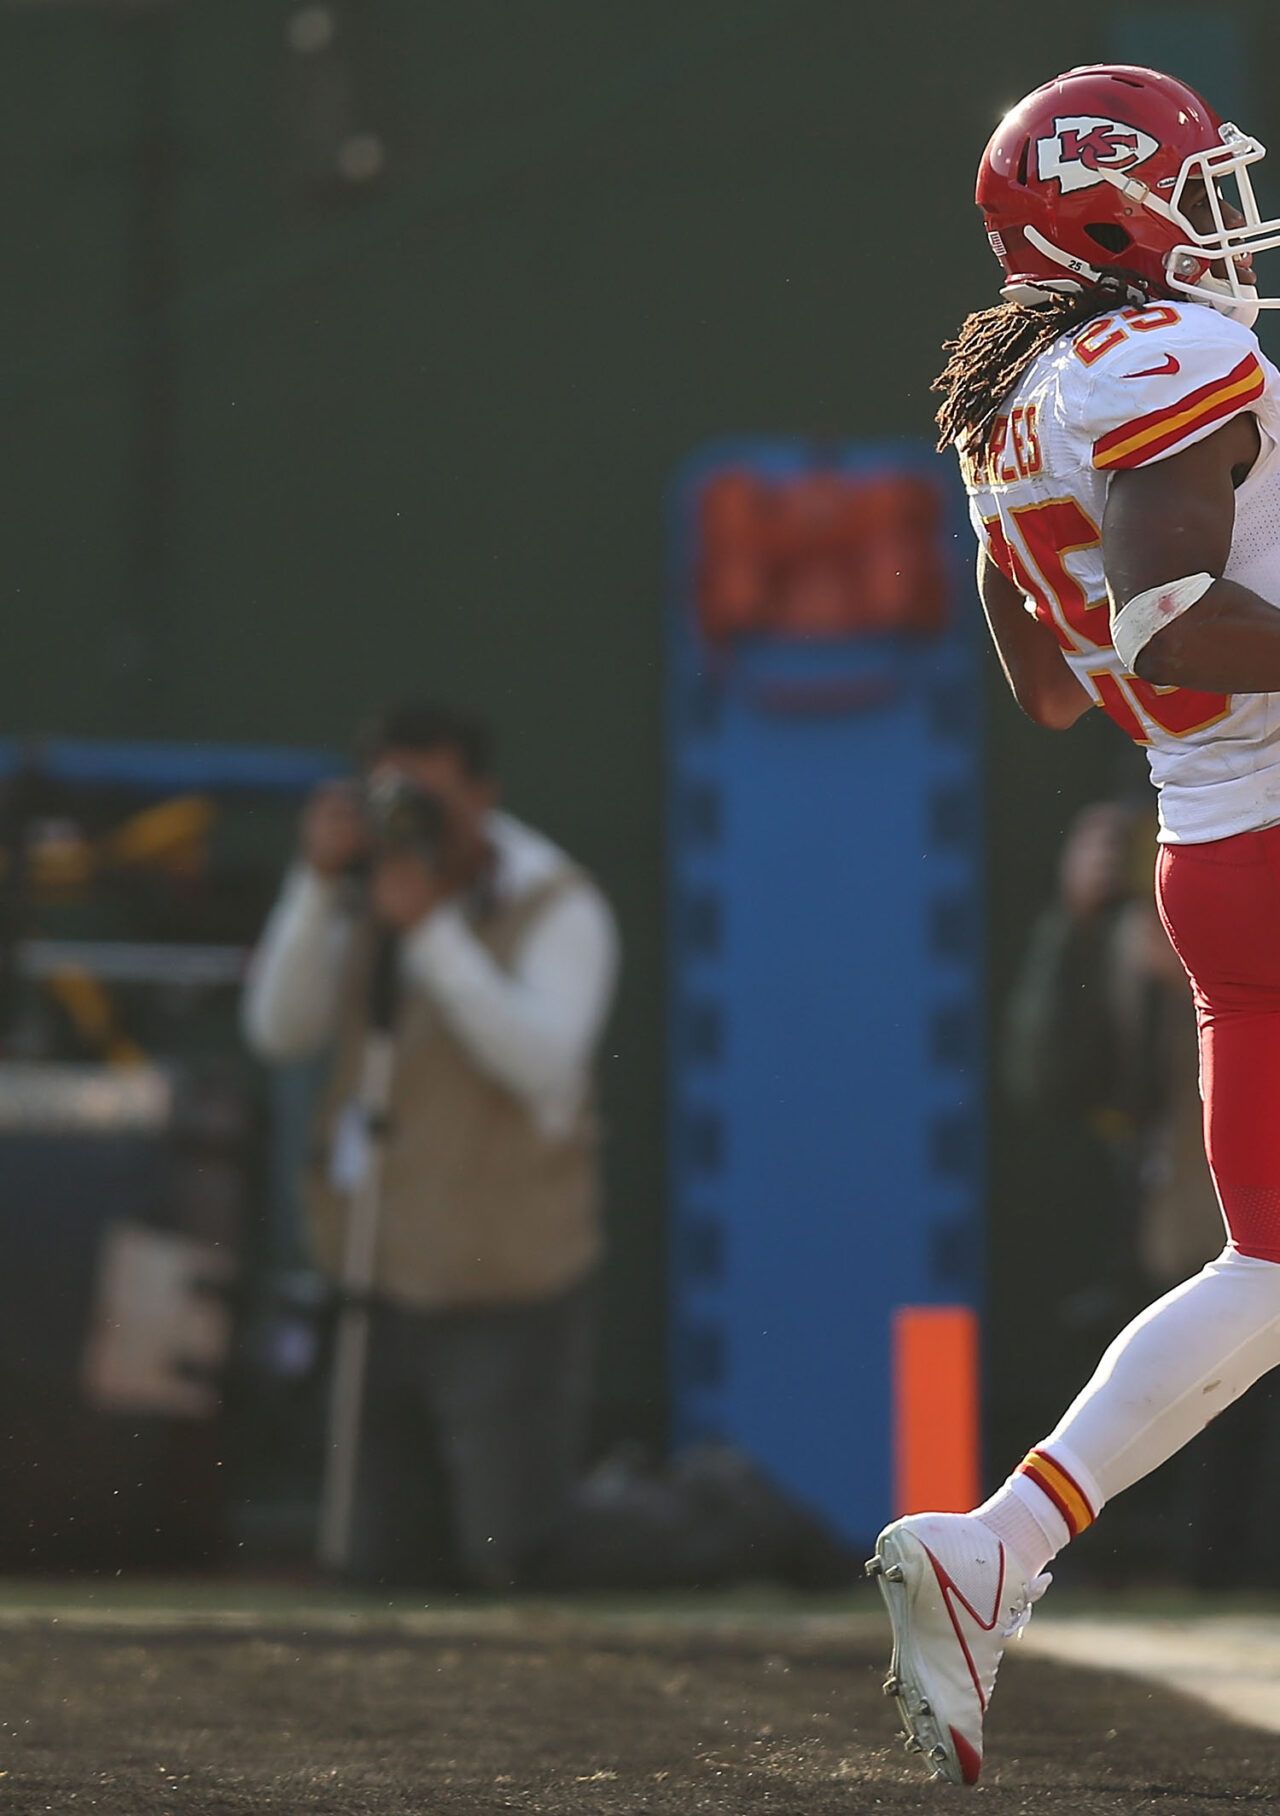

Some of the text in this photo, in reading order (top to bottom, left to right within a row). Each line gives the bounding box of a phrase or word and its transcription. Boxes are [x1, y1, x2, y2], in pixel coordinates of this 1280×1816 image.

[1057, 124, 1140, 172] KC
[1067, 259, 1083, 273] 25
[1073, 303, 1182, 369] 25
